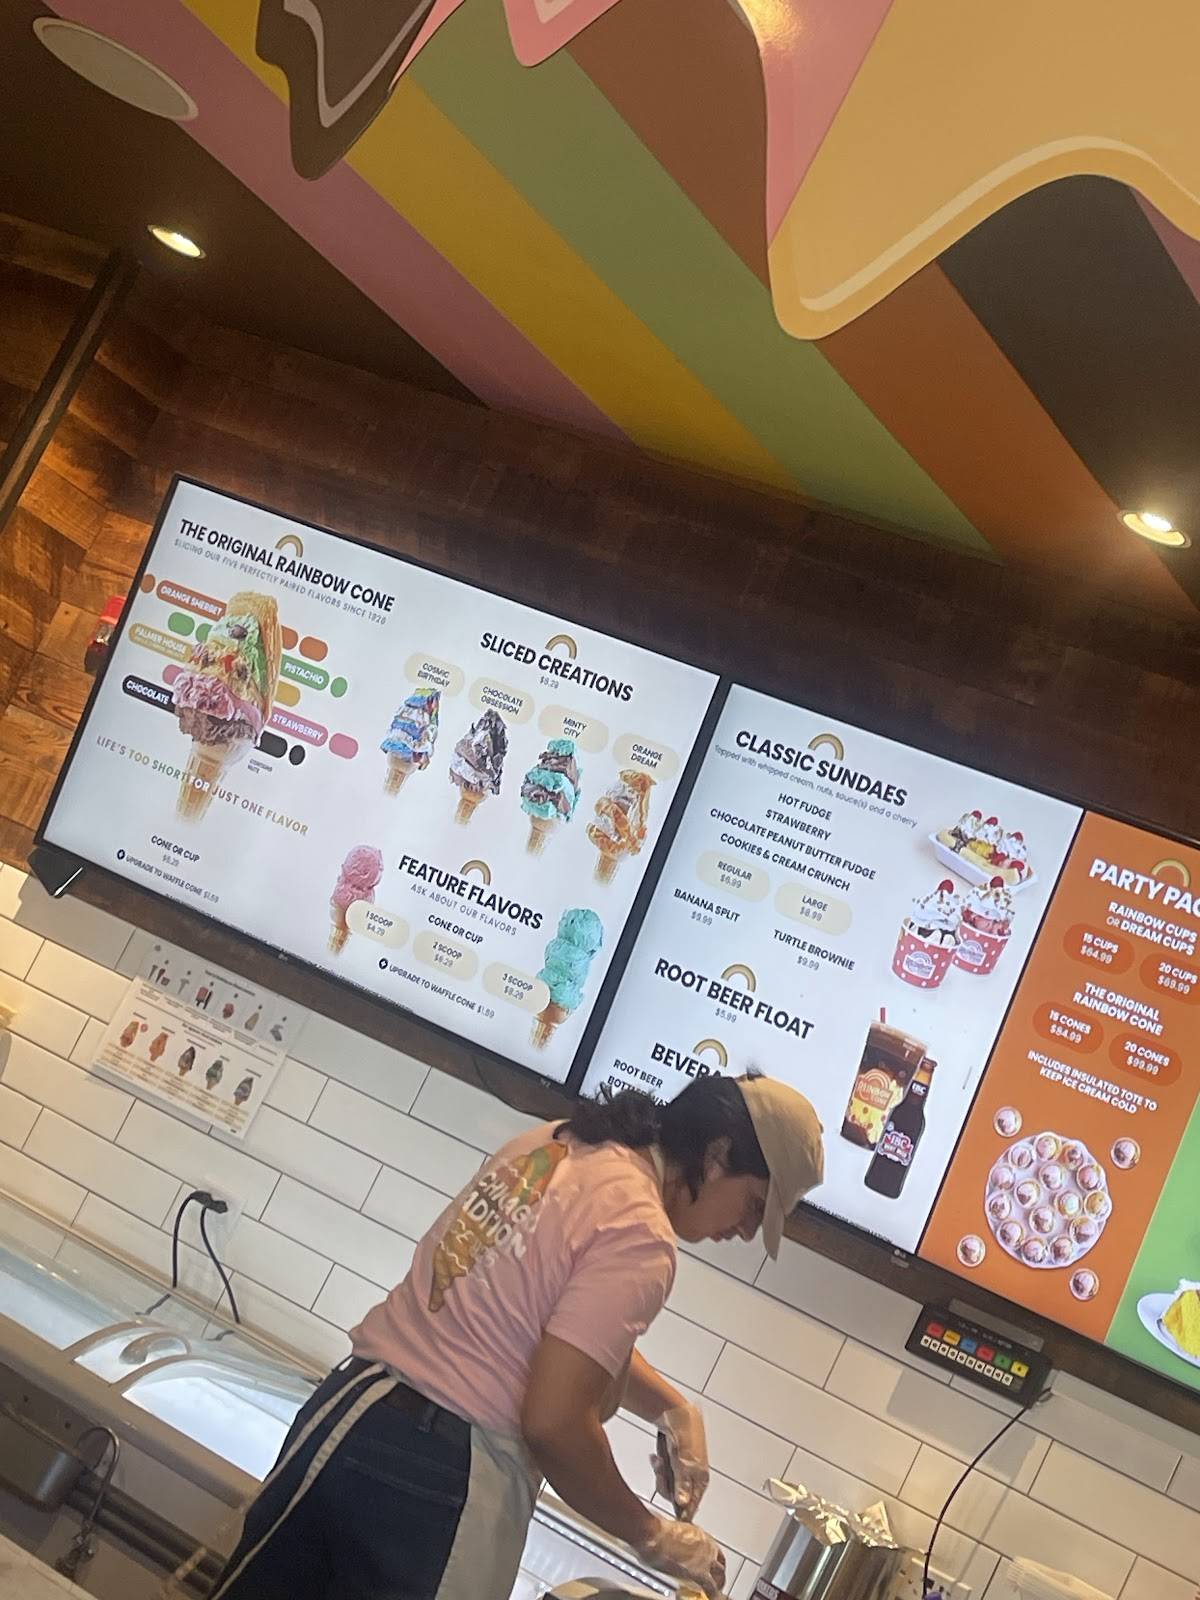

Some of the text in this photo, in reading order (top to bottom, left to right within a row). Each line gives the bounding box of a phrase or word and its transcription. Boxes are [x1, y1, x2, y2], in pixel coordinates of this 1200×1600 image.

[174, 538, 203, 556] SLICING
[205, 550, 221, 563] OUR
[222, 556, 238, 569] FIVE
[239, 563, 279, 583] PERFECTLY
[279, 578, 306, 594] PAIRED
[307, 589, 341, 608] FLAVORS
[342, 602, 366, 617] SINCE
[180, 519, 395, 612] THE ORIGINAL RAINBOW CONE
[160, 585, 191, 603] ORANGE
[284, 662, 324, 684] PISTACHIO
[417, 670, 450, 687] BIRTHDAY
[422, 662, 450, 679] COSMIC
[480, 632, 634, 702] SLICED CREATIONS
[126, 680, 170, 705] CHOCOLATE
[480, 695, 520, 715] OBSESSION
[482, 686, 524, 708] CHOCOLATE
[272, 713, 323, 741] STRAWBERRY
[563, 716, 587, 732] MINTY
[563, 727, 581, 739] CITY
[630, 753, 658, 769] DREAM
[632, 743, 664, 762] ORANGE
[736, 730, 908, 807] CLASSIC SUNDAES
[96, 735, 309, 836] LIFE'S TOO SHORT FOR JUST ONE FLAVOR
[741, 755, 757, 767] with
[757, 762, 790, 779] whipped
[868, 803, 885, 815] and
[885, 810, 892, 818] a
[892, 812, 918, 828] cherry
[778, 793, 833, 821] HOT FUDGE
[765, 809, 832, 841] STRAWBERRY
[151, 835, 200, 863] CONE OR CUP
[710, 808, 877, 880] CHOCOLATE PEANUT BUTTER FUDGE
[126, 855, 154, 873] UPGRADE
[154, 867, 162, 877] TO
[162, 872, 185, 888] WAFFLE
[185, 882, 203, 896] CONE
[717, 860, 752, 881] REGULAR
[720, 833, 851, 892] COOKIES & CREAM CRUNCH
[398, 854, 544, 930] FEATURE FLAVORS
[1088, 858, 1165, 900] PARTY
[410, 883, 517, 936] ASK ABOUT OUR FLAVORS
[673, 888, 740, 923] BANANA SPLIT
[802, 895, 829, 912] LARGE
[369, 912, 394, 928] SCOOP
[428, 914, 484, 945] CONE OR CUP
[1108, 901, 1198, 943] RAINBOW CUPS
[437, 943, 463, 960] SCOOP
[773, 928, 855, 971] TURTLE BROWNIE
[1083, 932, 1119, 954] 15 CUPS
[1106, 916, 1195, 956] OR DREAM CUPS
[389, 964, 422, 985] UPGRADE
[421, 978, 431, 989] TO
[430, 983, 456, 1001] WAFFLE
[455, 995, 477, 1010] CONE
[502, 973, 533, 991] 3 SCOOP
[1158, 962, 1198, 984] 20 CUPS
[653, 958, 815, 1040] ROOT BEER FLOAT
[1073, 991, 1164, 1036] RAINBOW CONE
[1085, 981, 1160, 1022] THE ORIGINAL
[1049, 1009, 1092, 1035] 15 CONES
[1124, 1040, 1170, 1067] 20 CONES
[613, 1058, 664, 1089] ROOT BEER
[1027, 1049, 1158, 1112] INCLUDES INSULATED TOTE TO
[1039, 1066, 1138, 1114] KEEP ICE CREAM COLD
